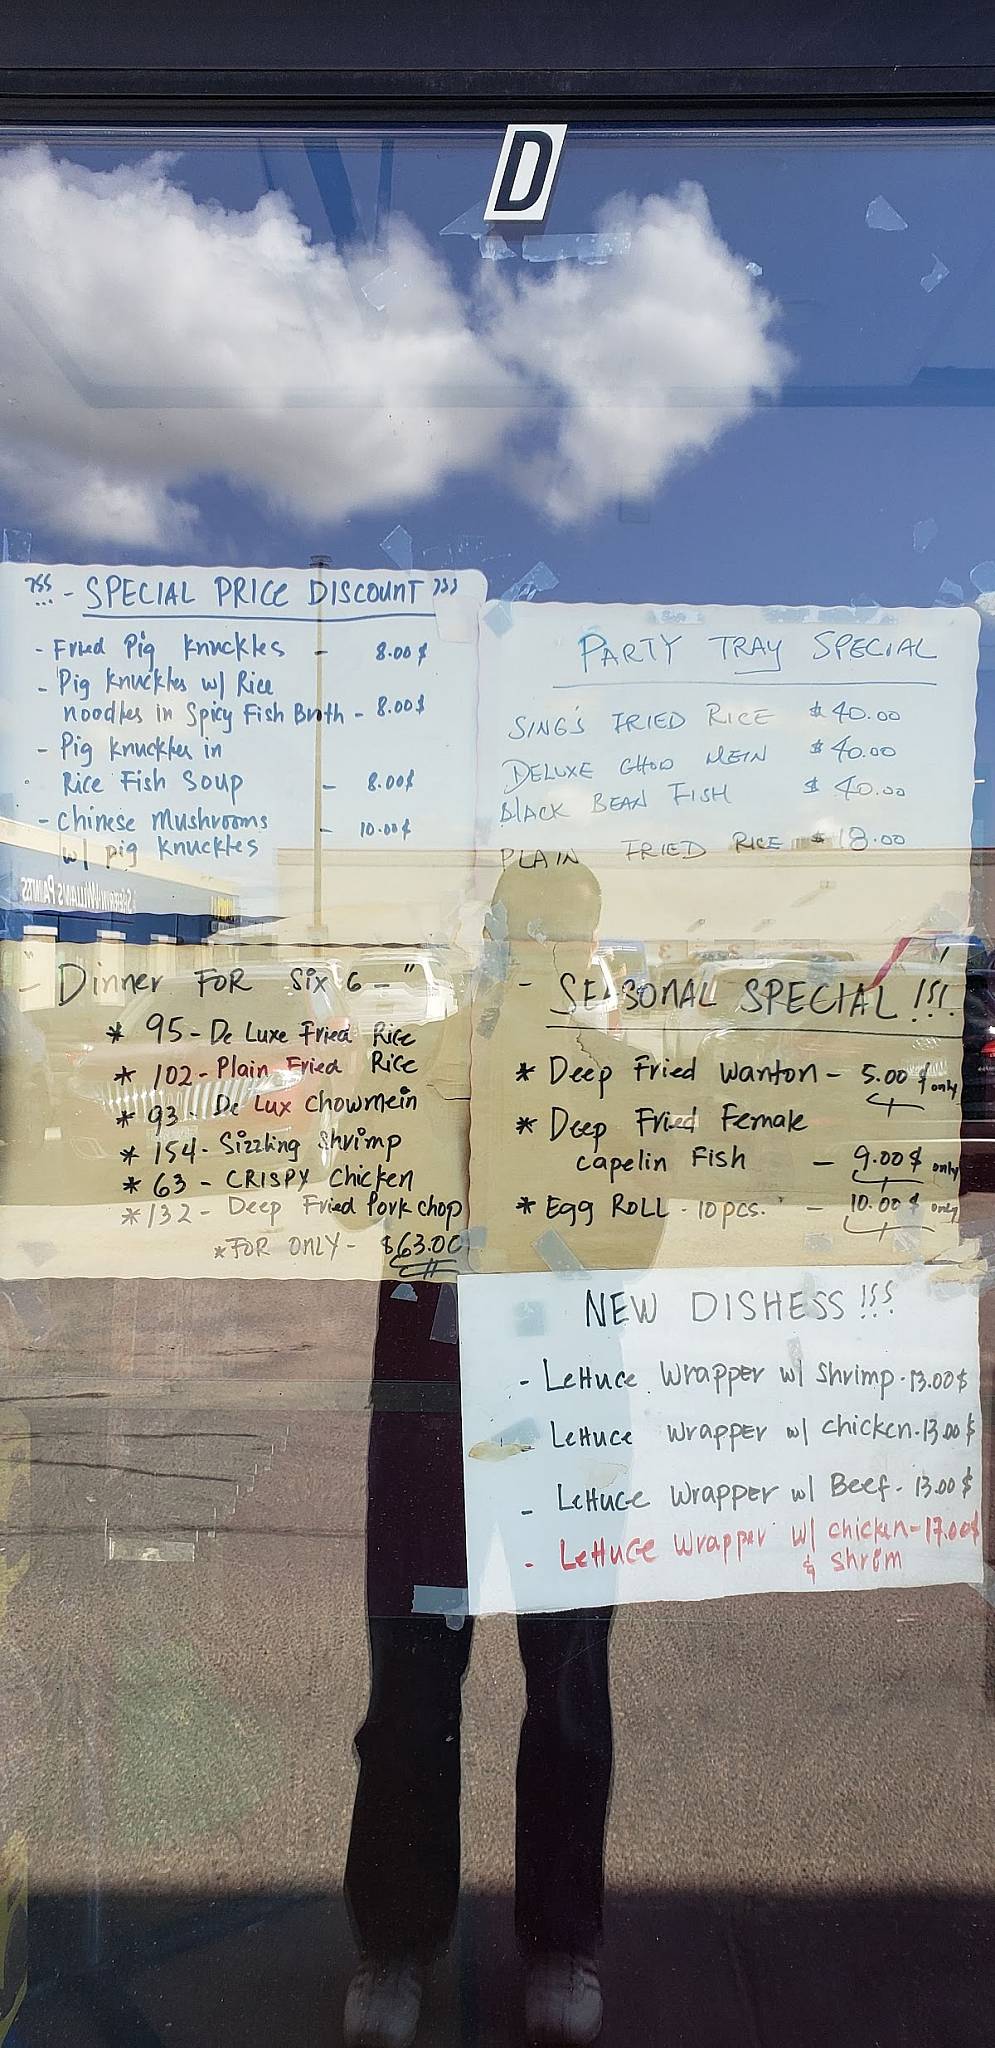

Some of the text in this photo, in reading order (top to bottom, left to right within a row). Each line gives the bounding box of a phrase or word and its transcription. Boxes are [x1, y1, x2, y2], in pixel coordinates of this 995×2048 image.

[494, 131, 553, 211] D
[86, 575, 195, 609] SPECIAL
[54, 637, 105, 660] Fried
[124, 631, 155, 672] Pig
[578, 630, 937, 675] PARTY TRAY SPECIAL
[58, 667, 90, 700] Pig
[237, 669, 273, 696] Rice
[64, 701, 144, 723] noodles
[156, 701, 172, 722] in
[186, 703, 233, 736] Spicy
[243, 703, 284, 724] Fish
[294, 703, 344, 724] Broth
[508, 706, 585, 740] SING'S
[612, 711, 685, 734] FRIED
[706, 702, 776, 728] RICE
[60, 733, 92, 767] Pig
[204, 737, 222, 758] in
[62, 770, 103, 796] Rice
[120, 766, 166, 793] Fish
[183, 769, 243, 806] Soup
[501, 759, 594, 795] DELUXE
[592, 789, 647, 814] BEAN
[668, 782, 732, 806] FISH
[105, 839, 138, 869] pig
[500, 848, 579, 871] PLAIN
[621, 839, 707, 861] FRIED
[734, 831, 783, 853] RICE
[58, 961, 164, 1007] Dinner
[194, 967, 252, 998] FOR
[346, 970, 362, 993] 6
[739, 977, 897, 1020] SPECIAL
[245, 1022, 289, 1044] Luxe
[299, 1019, 353, 1045] Fried
[371, 1021, 416, 1047] Rice
[217, 1055, 270, 1079] Plain
[287, 1054, 342, 1075] Fried
[370, 1050, 418, 1075] Rice
[549, 1057, 612, 1098] Deep
[635, 1057, 698, 1082] Fried
[253, 1094, 292, 1114] Lux
[550, 1106, 607, 1149] Deep
[636, 1107, 698, 1133] Fried
[691, 1146, 747, 1170] Fish
[226, 1168, 310, 1190] CRISPY
[228, 1196, 282, 1226] Deep
[303, 1194, 355, 1214] Fried
[366, 1187, 412, 1219] Pork
[545, 1196, 595, 1226] Egg
[584, 1290, 657, 1327] NEW
[831, 1474, 891, 1503] Beef
